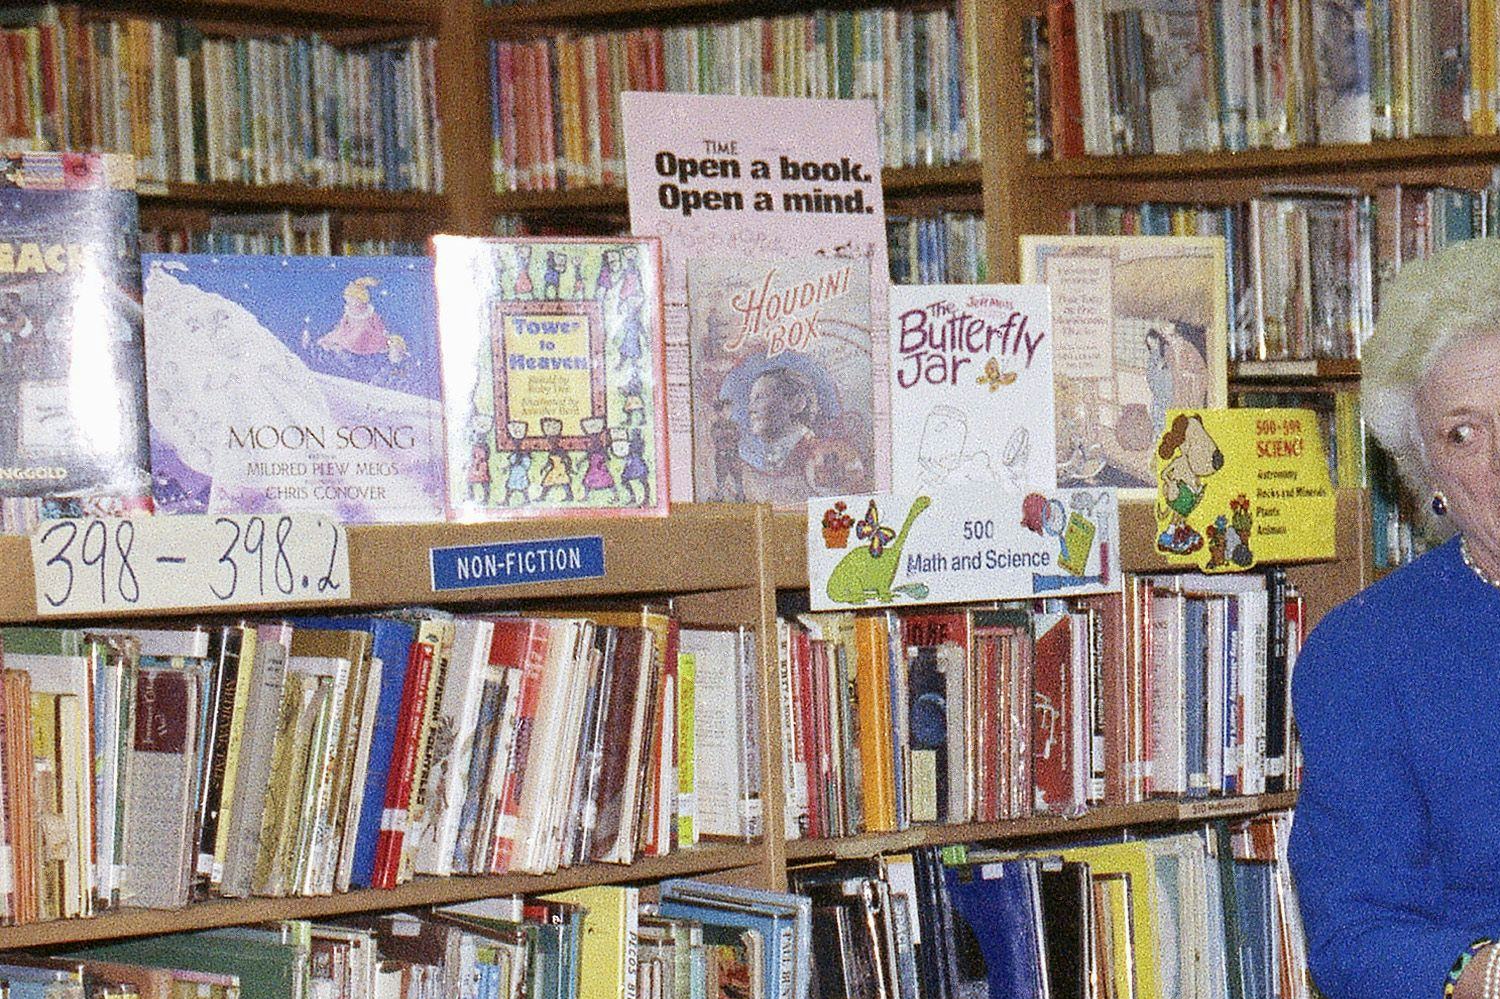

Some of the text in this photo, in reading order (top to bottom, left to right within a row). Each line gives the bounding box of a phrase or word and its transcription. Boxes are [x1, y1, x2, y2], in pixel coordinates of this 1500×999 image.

[703, 140, 738, 155] TIME
[655, 151, 872, 184] Open a book.
[658, 183, 874, 217] Open a mind.
[726, 267, 851, 351] HOUDINI
[926, 299, 957, 318] The
[512, 318, 581, 335] Tower
[767, 310, 819, 355] BOX
[897, 308, 1045, 369] Butterfly
[539, 340, 556, 351] to
[508, 354, 588, 370] Heaven
[897, 350, 971, 389] Jar
[228, 425, 416, 450] MOON SONG
[247, 462, 400, 477] MILDRED PLEW MEIGS
[265, 486, 386, 501] CHRIS CONOVER
[963, 519, 995, 541] 500
[41, 519, 140, 607] 398
[210, 515, 341, 601] 398.2
[457, 547, 582, 581] NON-FICTION
[906, 549, 1051, 576] Math and Science
[626, 930, 637, 975] PECOS
